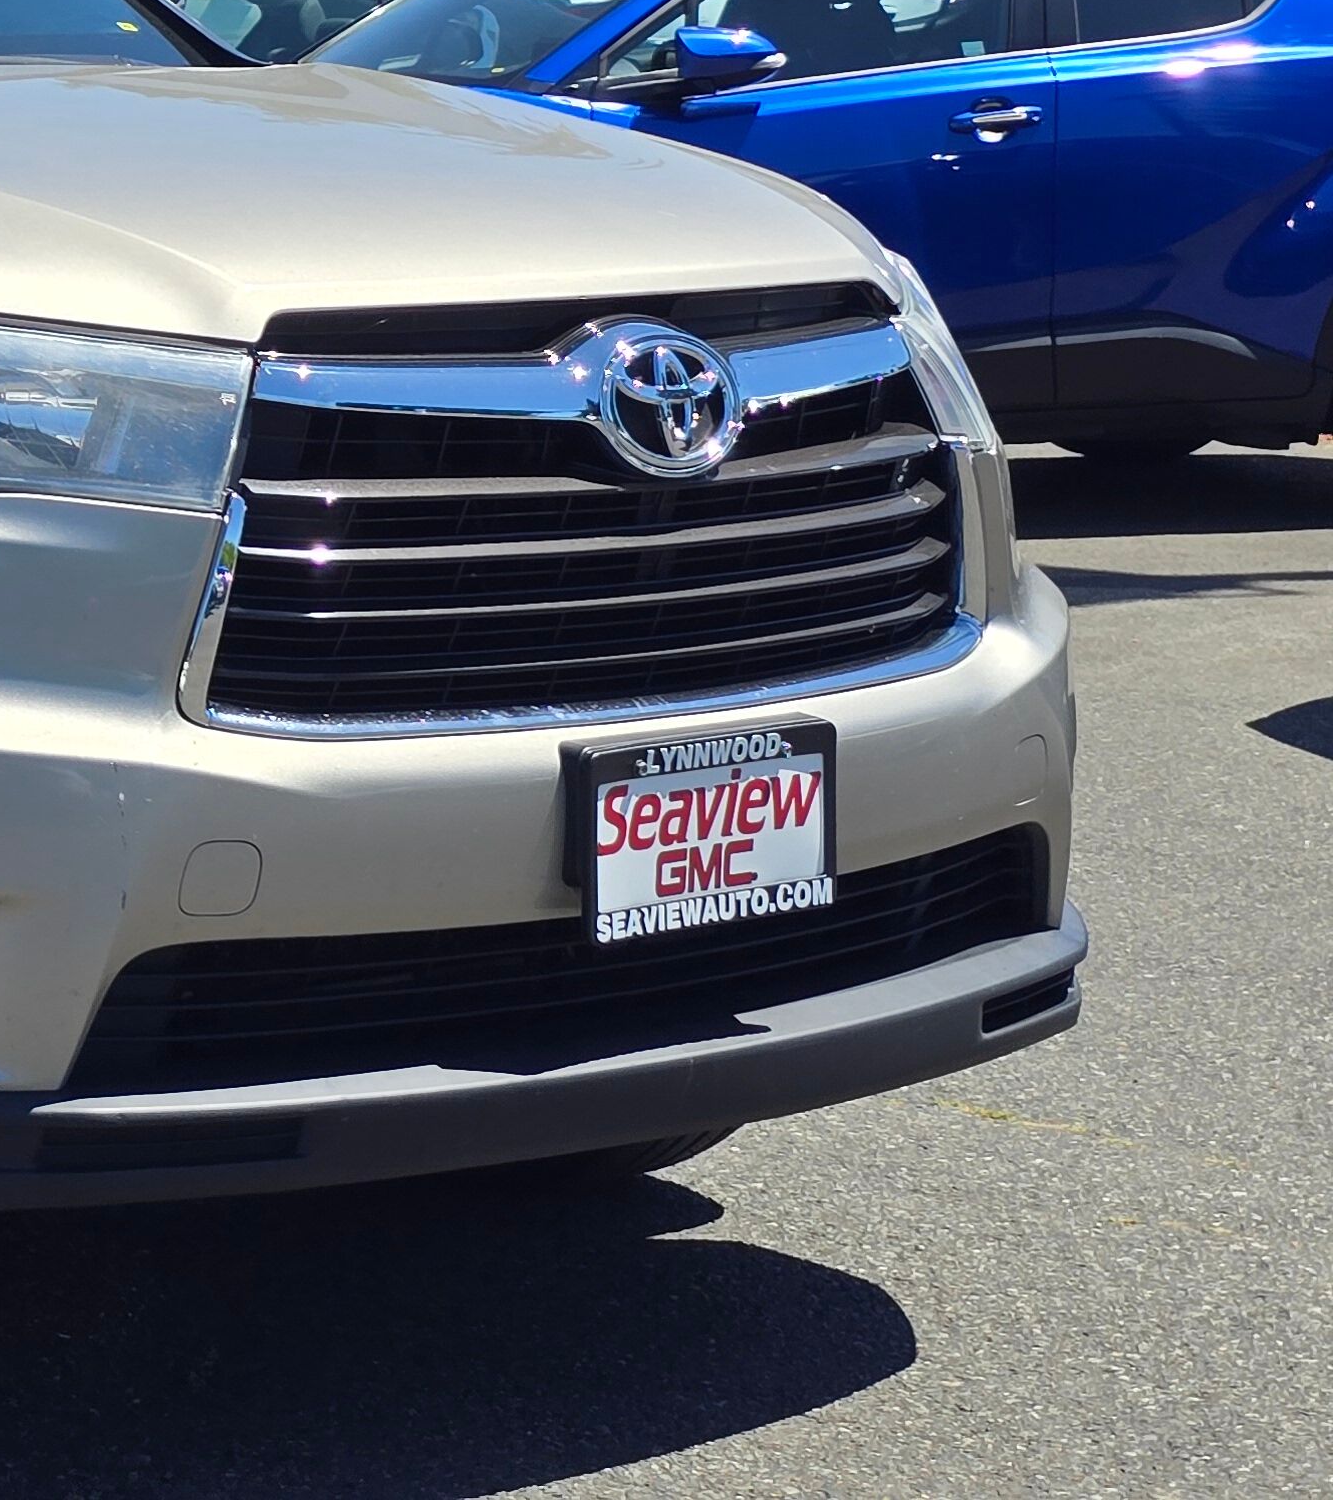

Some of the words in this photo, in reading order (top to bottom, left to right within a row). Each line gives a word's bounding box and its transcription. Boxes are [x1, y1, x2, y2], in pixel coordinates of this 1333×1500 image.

[645, 732, 782, 775] LYNNWOOD
[597, 768, 822, 857] Seaview
[655, 839, 758, 898] GMC
[596, 877, 834, 944] SEAVIEWAUTO.COM
